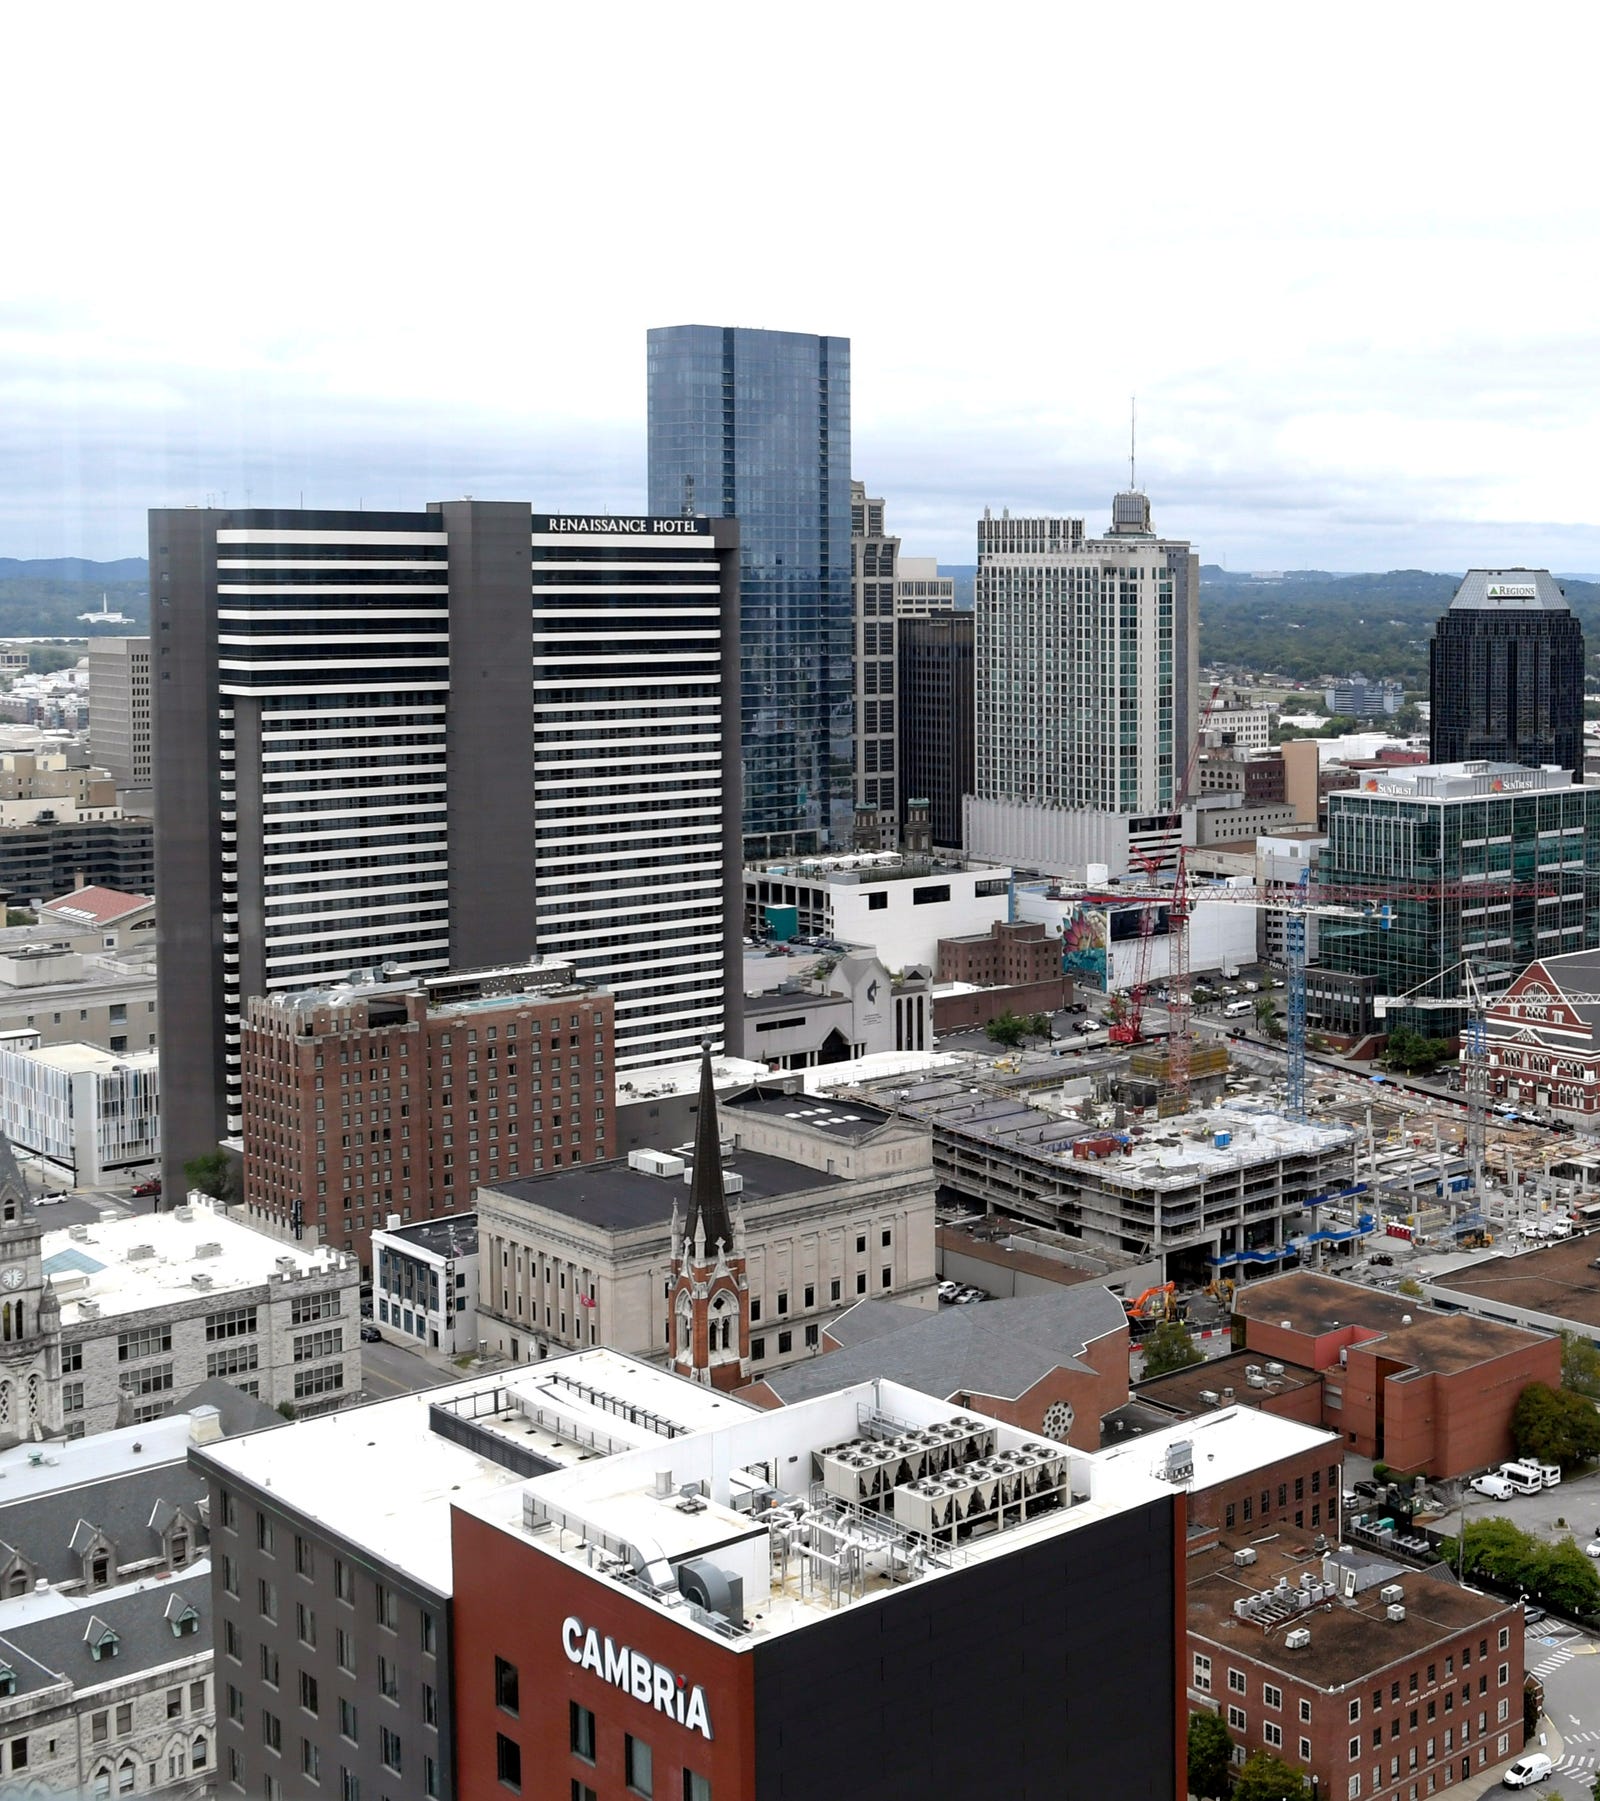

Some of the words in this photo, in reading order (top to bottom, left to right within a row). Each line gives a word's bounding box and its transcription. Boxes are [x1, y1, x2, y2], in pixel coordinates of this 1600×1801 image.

[549, 518, 647, 532] RENAISSANCE
[653, 520, 698, 533] HOTEL
[1499, 586, 1535, 595] REGIONS
